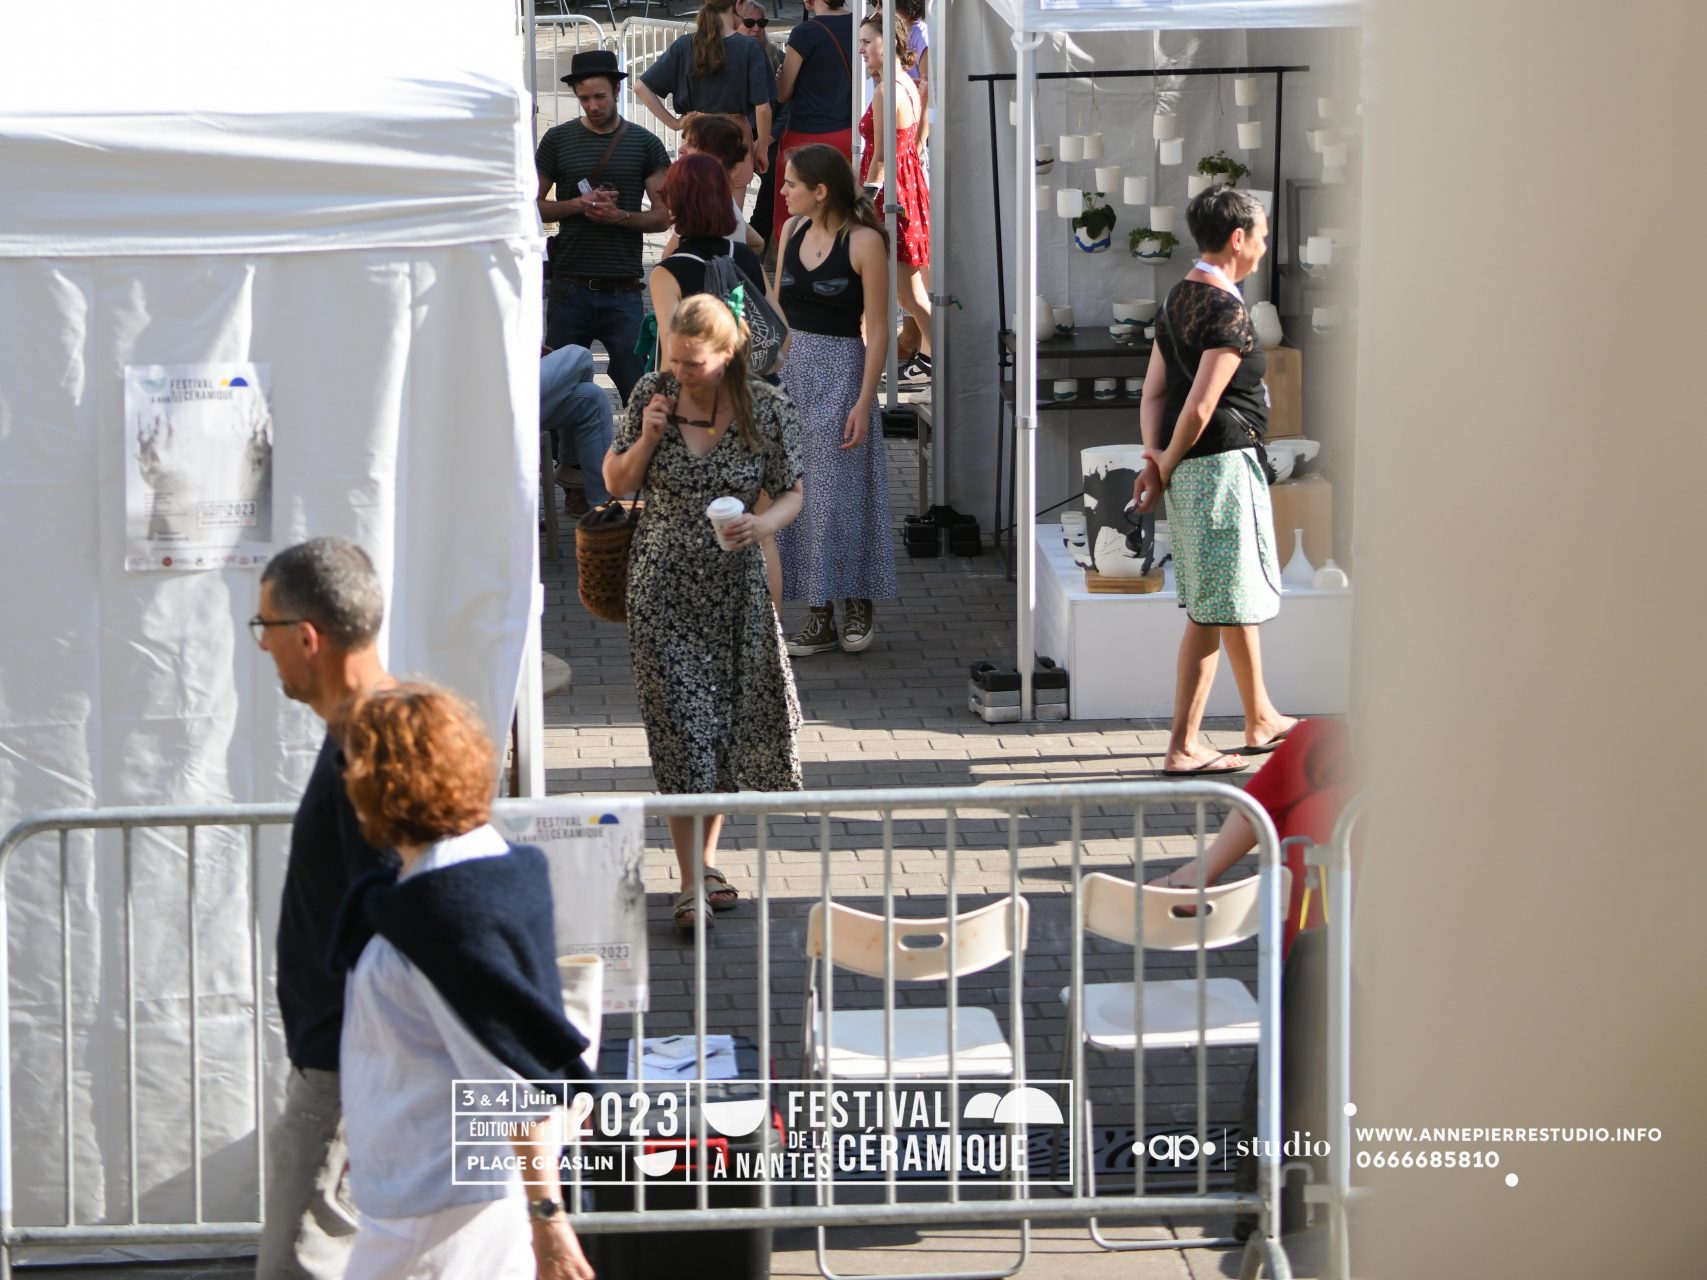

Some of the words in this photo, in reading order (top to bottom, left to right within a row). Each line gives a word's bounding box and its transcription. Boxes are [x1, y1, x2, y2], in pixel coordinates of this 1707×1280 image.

[170, 379, 214, 390] FESTIVAL
[227, 503, 255, 515] 2023
[536, 816, 582, 827] FESTIVAL
[600, 945, 629, 959] 2023
